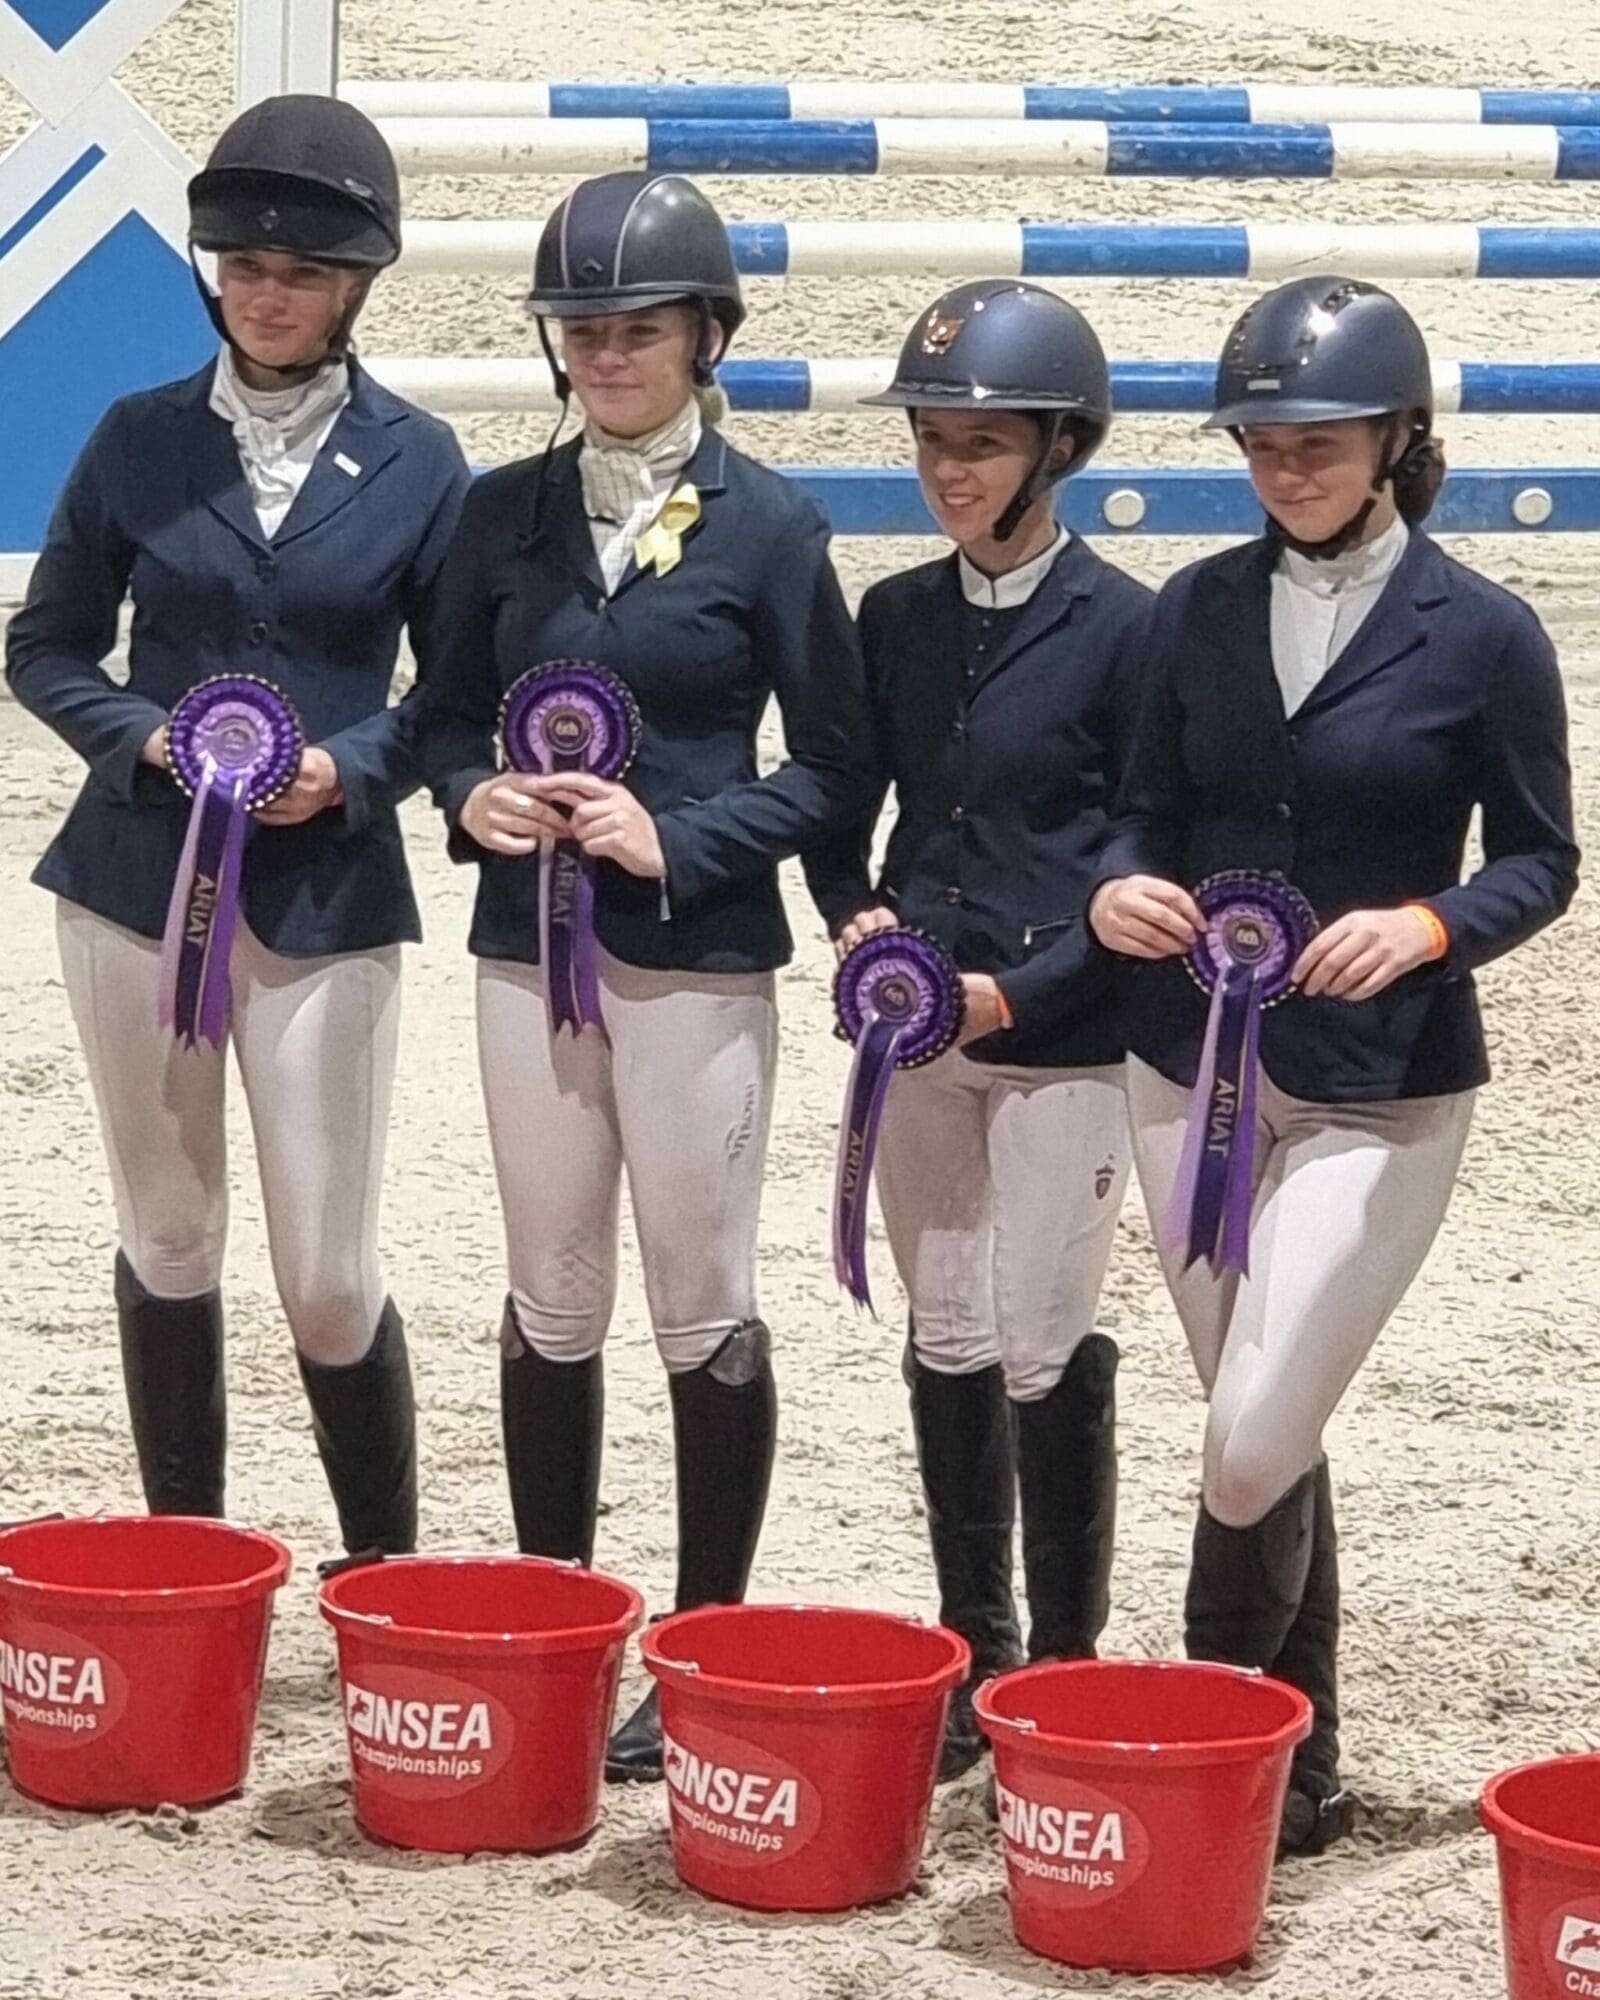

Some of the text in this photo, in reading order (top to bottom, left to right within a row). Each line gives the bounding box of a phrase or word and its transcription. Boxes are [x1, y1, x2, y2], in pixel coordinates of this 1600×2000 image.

[186, 872, 216, 945] ARIAT
[552, 851, 578, 925] ARIAT
[1207, 1078, 1237, 1158] ARIAT
[6, 1642, 106, 1705] NSEA
[374, 1695, 492, 1751] NSEA
[683, 1753, 798, 1828] NSEA
[1015, 1796, 1126, 1862] NSEA
